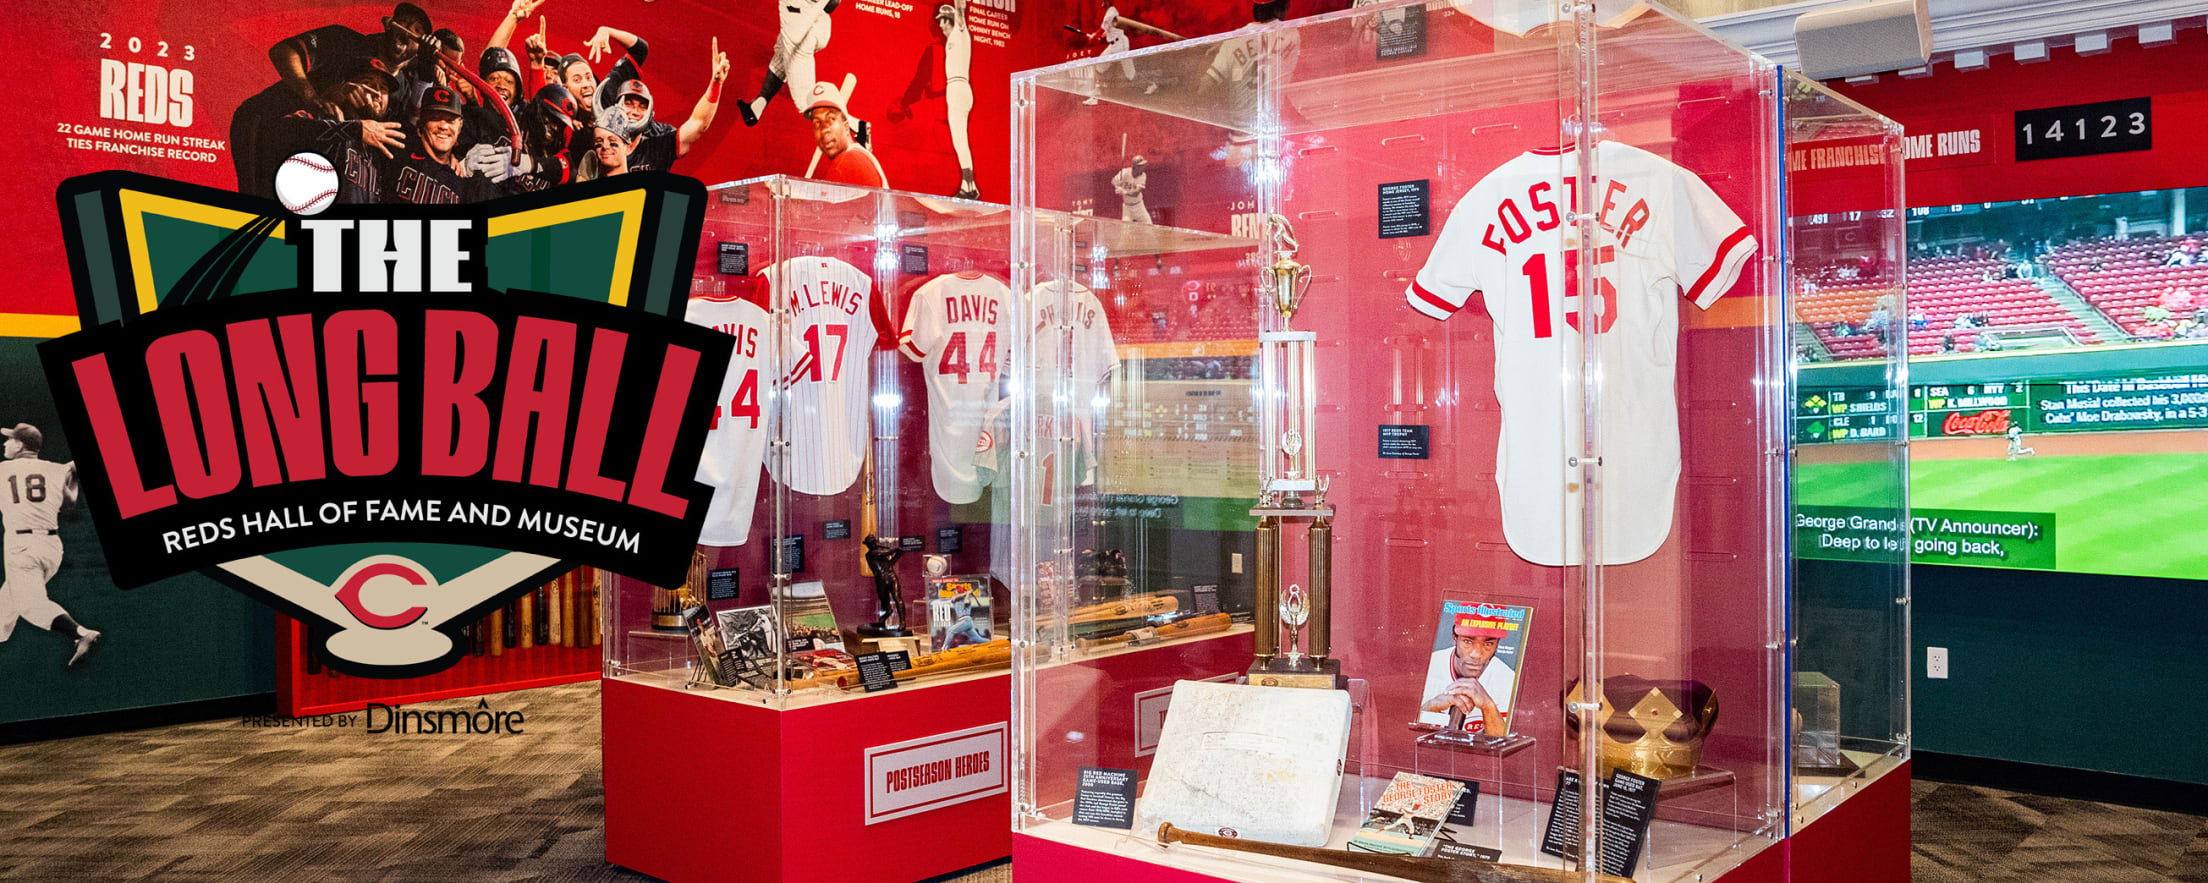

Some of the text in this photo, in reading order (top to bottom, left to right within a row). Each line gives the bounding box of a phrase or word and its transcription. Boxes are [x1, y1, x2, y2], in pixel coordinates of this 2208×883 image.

[100, 32, 195, 61] 2023
[100, 58, 193, 128] REDS
[57, 122, 226, 151] 22 GAME HOME RUN STREAK
[1811, 143, 1886, 170] FRANCHISE
[1937, 129, 1981, 156] RUNS
[66, 137, 217, 163] TIES FRANCHISE RECORD
[1481, 175, 1650, 256] FOSTER
[1522, 244, 1618, 338] 15
[945, 294, 999, 326] DAVIS
[803, 324, 849, 383] 17
[939, 331, 997, 385] 44
[1831, 402, 1888, 413] WP SHIELDS
[1928, 399, 1946, 409] WP
[1957, 396, 2008, 408] MILLWOOD
[2102, 395, 2150, 407] collected
[2152, 394, 2169, 405] his
[2178, 410, 2187, 418] a
[1832, 429, 1849, 439] WP
[8, 473, 47, 504] 18
[1796, 513, 1846, 531] George
[1910, 517, 1937, 534] (TV
[1940, 518, 2039, 539] Announcer):
[1822, 533, 1861, 551] Deep
[1865, 535, 1880, 550] to
[1914, 537, 1957, 556] going
[1961, 538, 2005, 557] back,
[1443, 602, 1525, 619] Sports Illustrated
[886, 750, 990, 794] POSTSEASON HEROES
[1395, 780, 1411, 790] THE
[1383, 781, 1453, 803] GEORGE FOSTER
[1423, 791, 1453, 805] STORY
